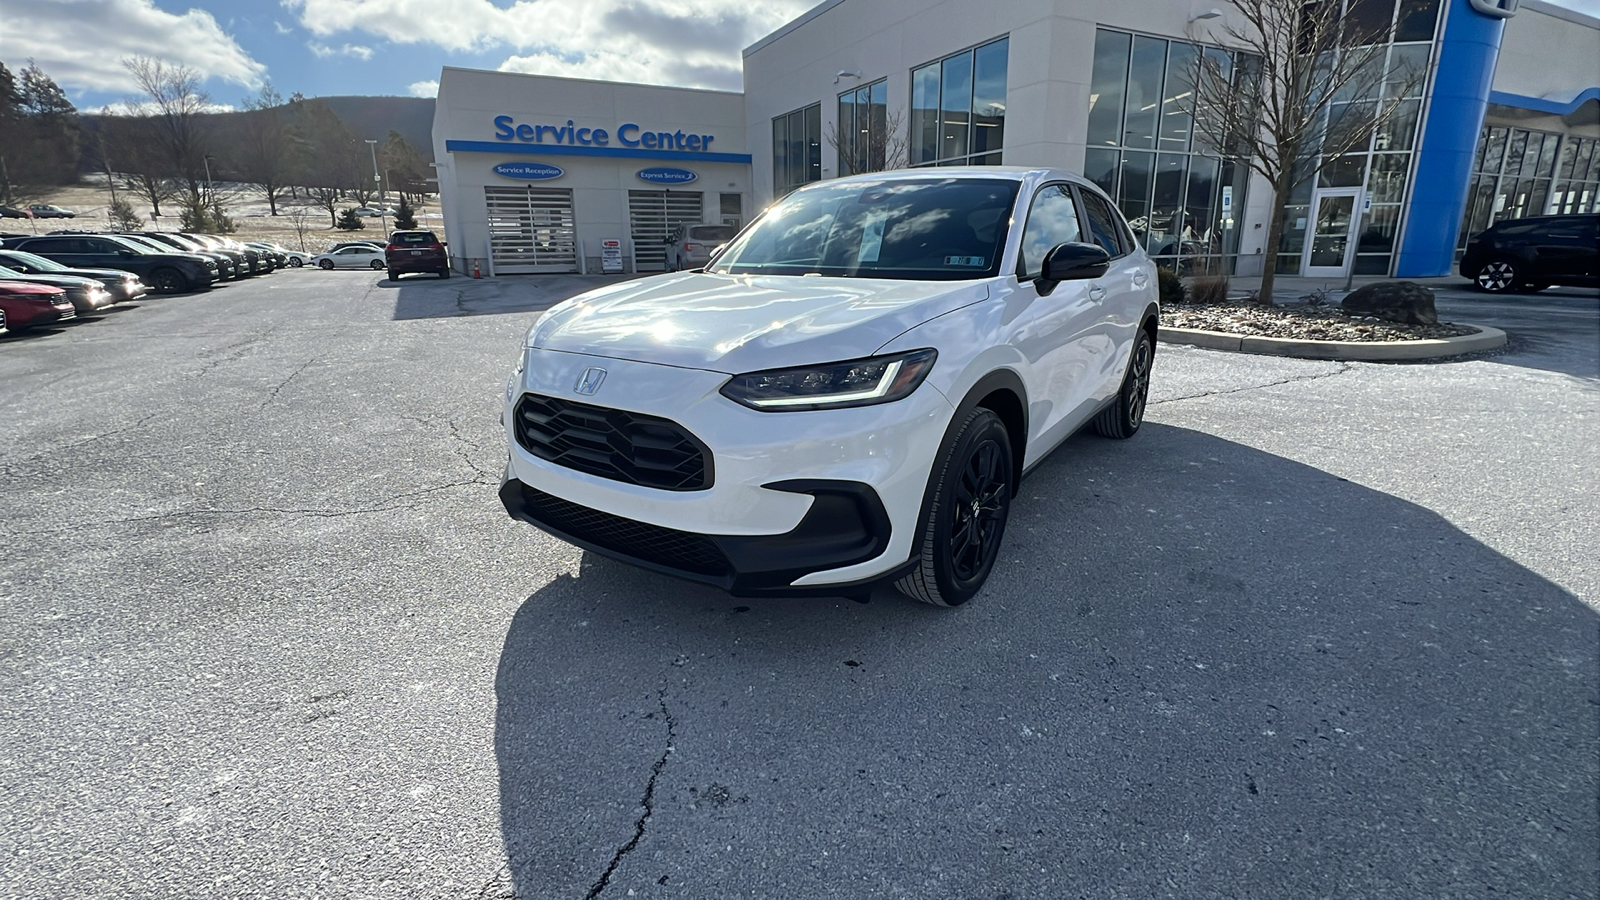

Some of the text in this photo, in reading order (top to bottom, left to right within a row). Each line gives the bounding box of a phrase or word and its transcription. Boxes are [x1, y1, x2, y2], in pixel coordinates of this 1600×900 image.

[494, 115, 714, 151] Service Center
[497, 166, 560, 176] Service Reception
[640, 171, 663, 179] Express
